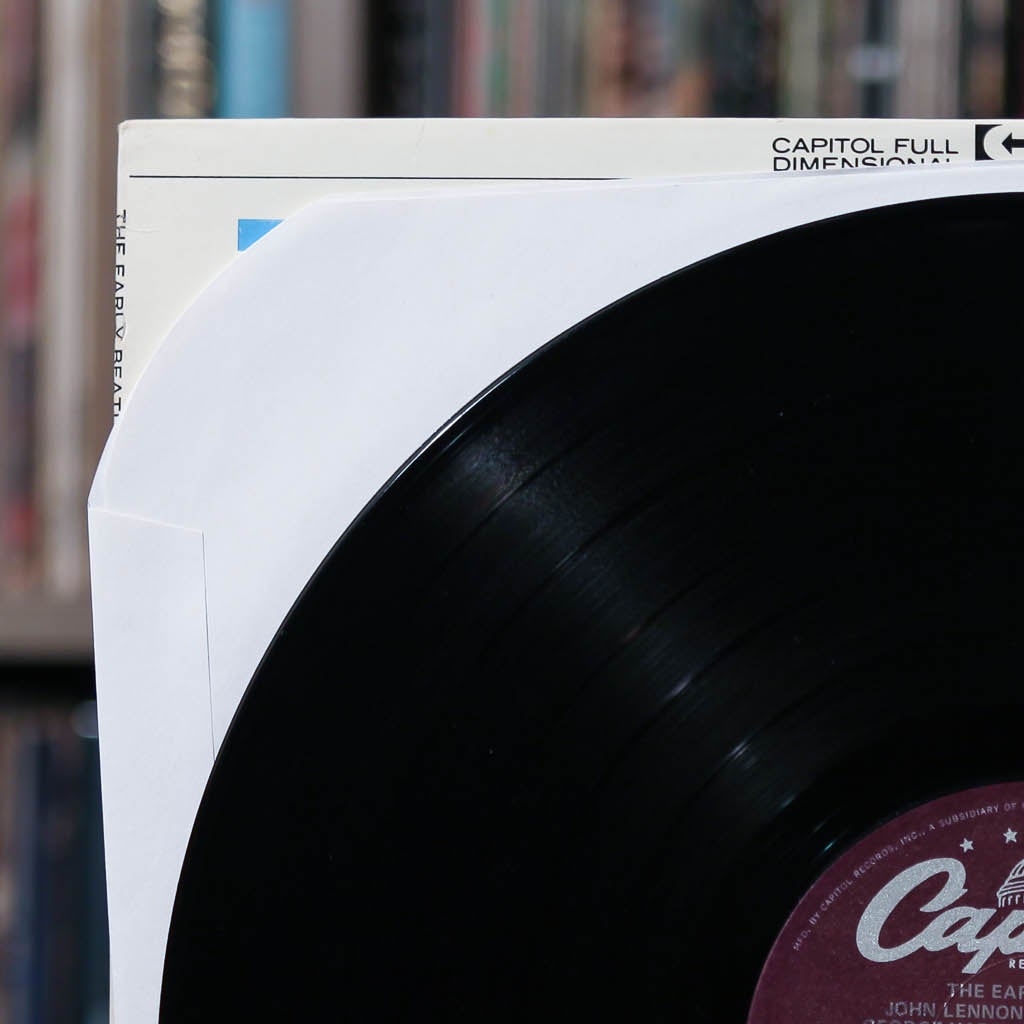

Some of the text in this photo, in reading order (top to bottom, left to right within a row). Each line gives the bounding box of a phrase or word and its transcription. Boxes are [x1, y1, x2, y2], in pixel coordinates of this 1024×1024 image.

[772, 137, 959, 155] CAPITOL FULL
[808, 913, 821, 926] BY
[820, 879, 853, 912] CAPITOL
[928, 823, 936, 831] A
[939, 804, 999, 828] SUBSIDIARY
[1003, 802, 1017, 812] OF
[947, 983, 985, 998] THE
[885, 1001, 936, 1018] JOHN
